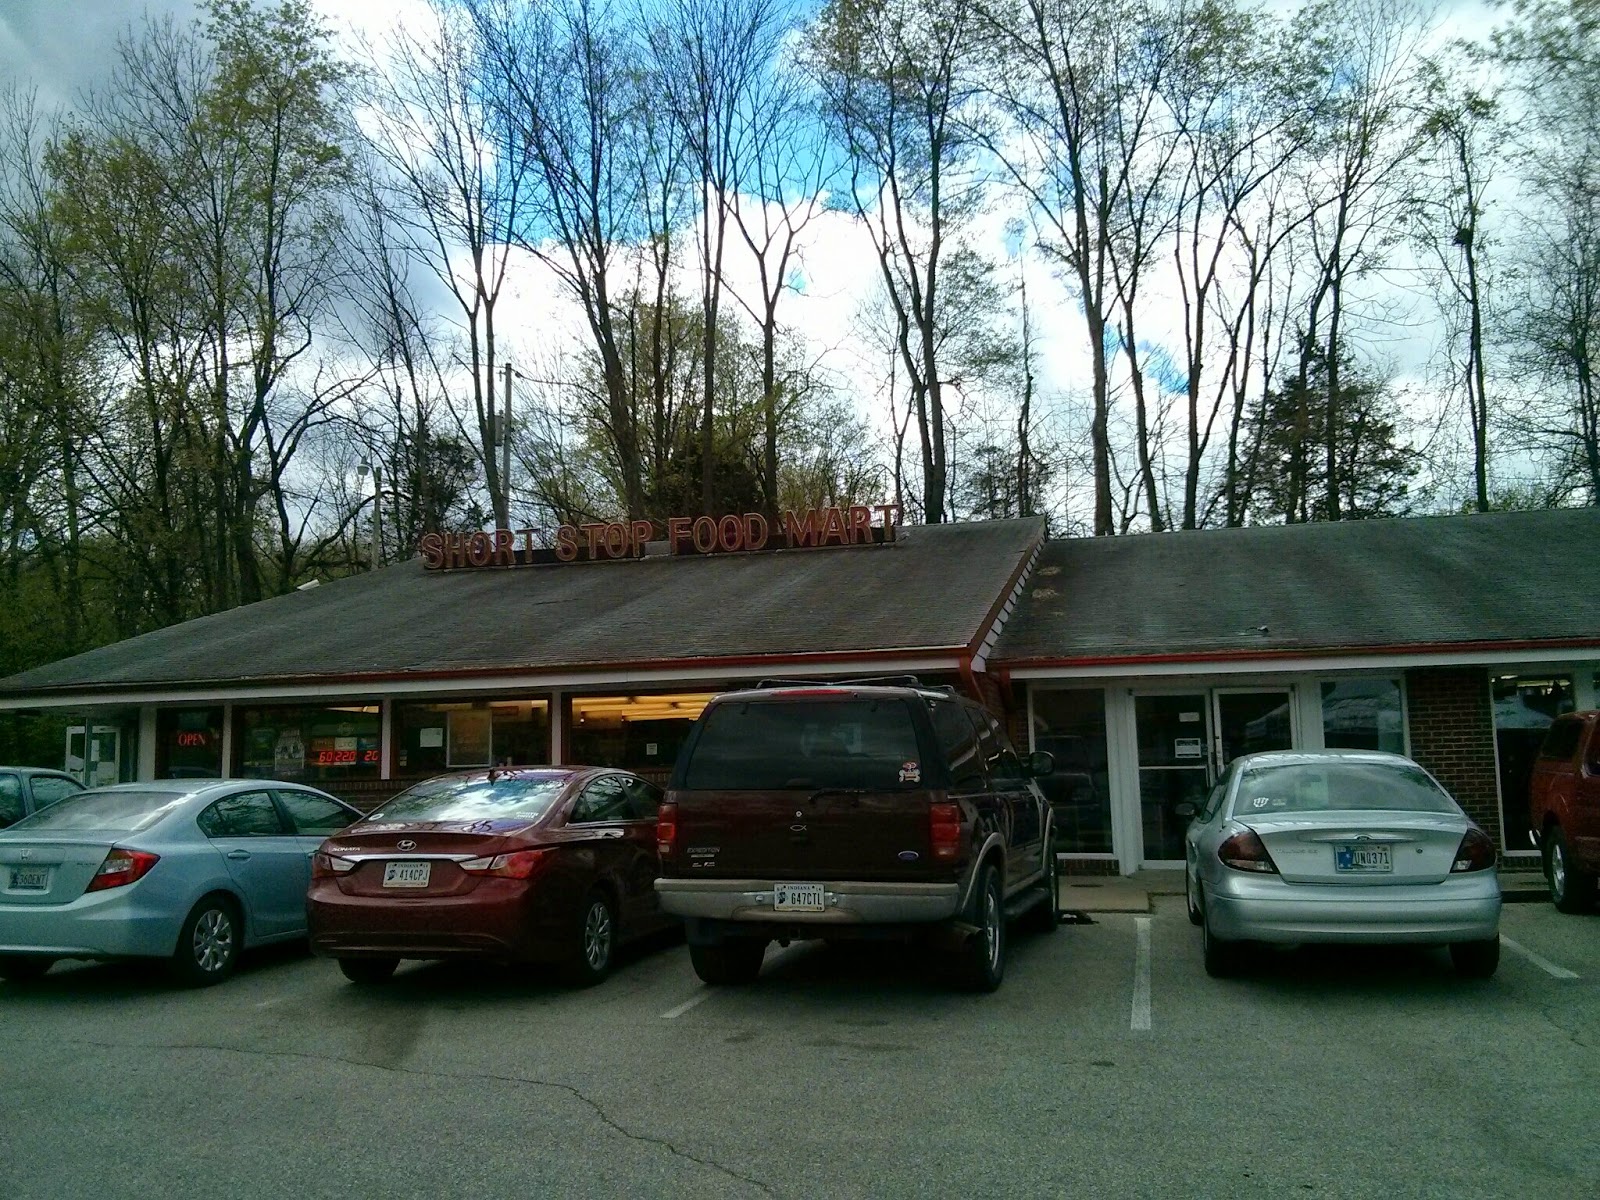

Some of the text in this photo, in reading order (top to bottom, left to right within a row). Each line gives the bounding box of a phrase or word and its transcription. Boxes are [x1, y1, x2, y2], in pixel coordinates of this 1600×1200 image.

[421, 504, 899, 570] SHORT STOP FOOD MART
[178, 732, 206, 746] OPEN
[399, 869, 429, 881] 414CPJ
[791, 892, 822, 905] 647CTL
